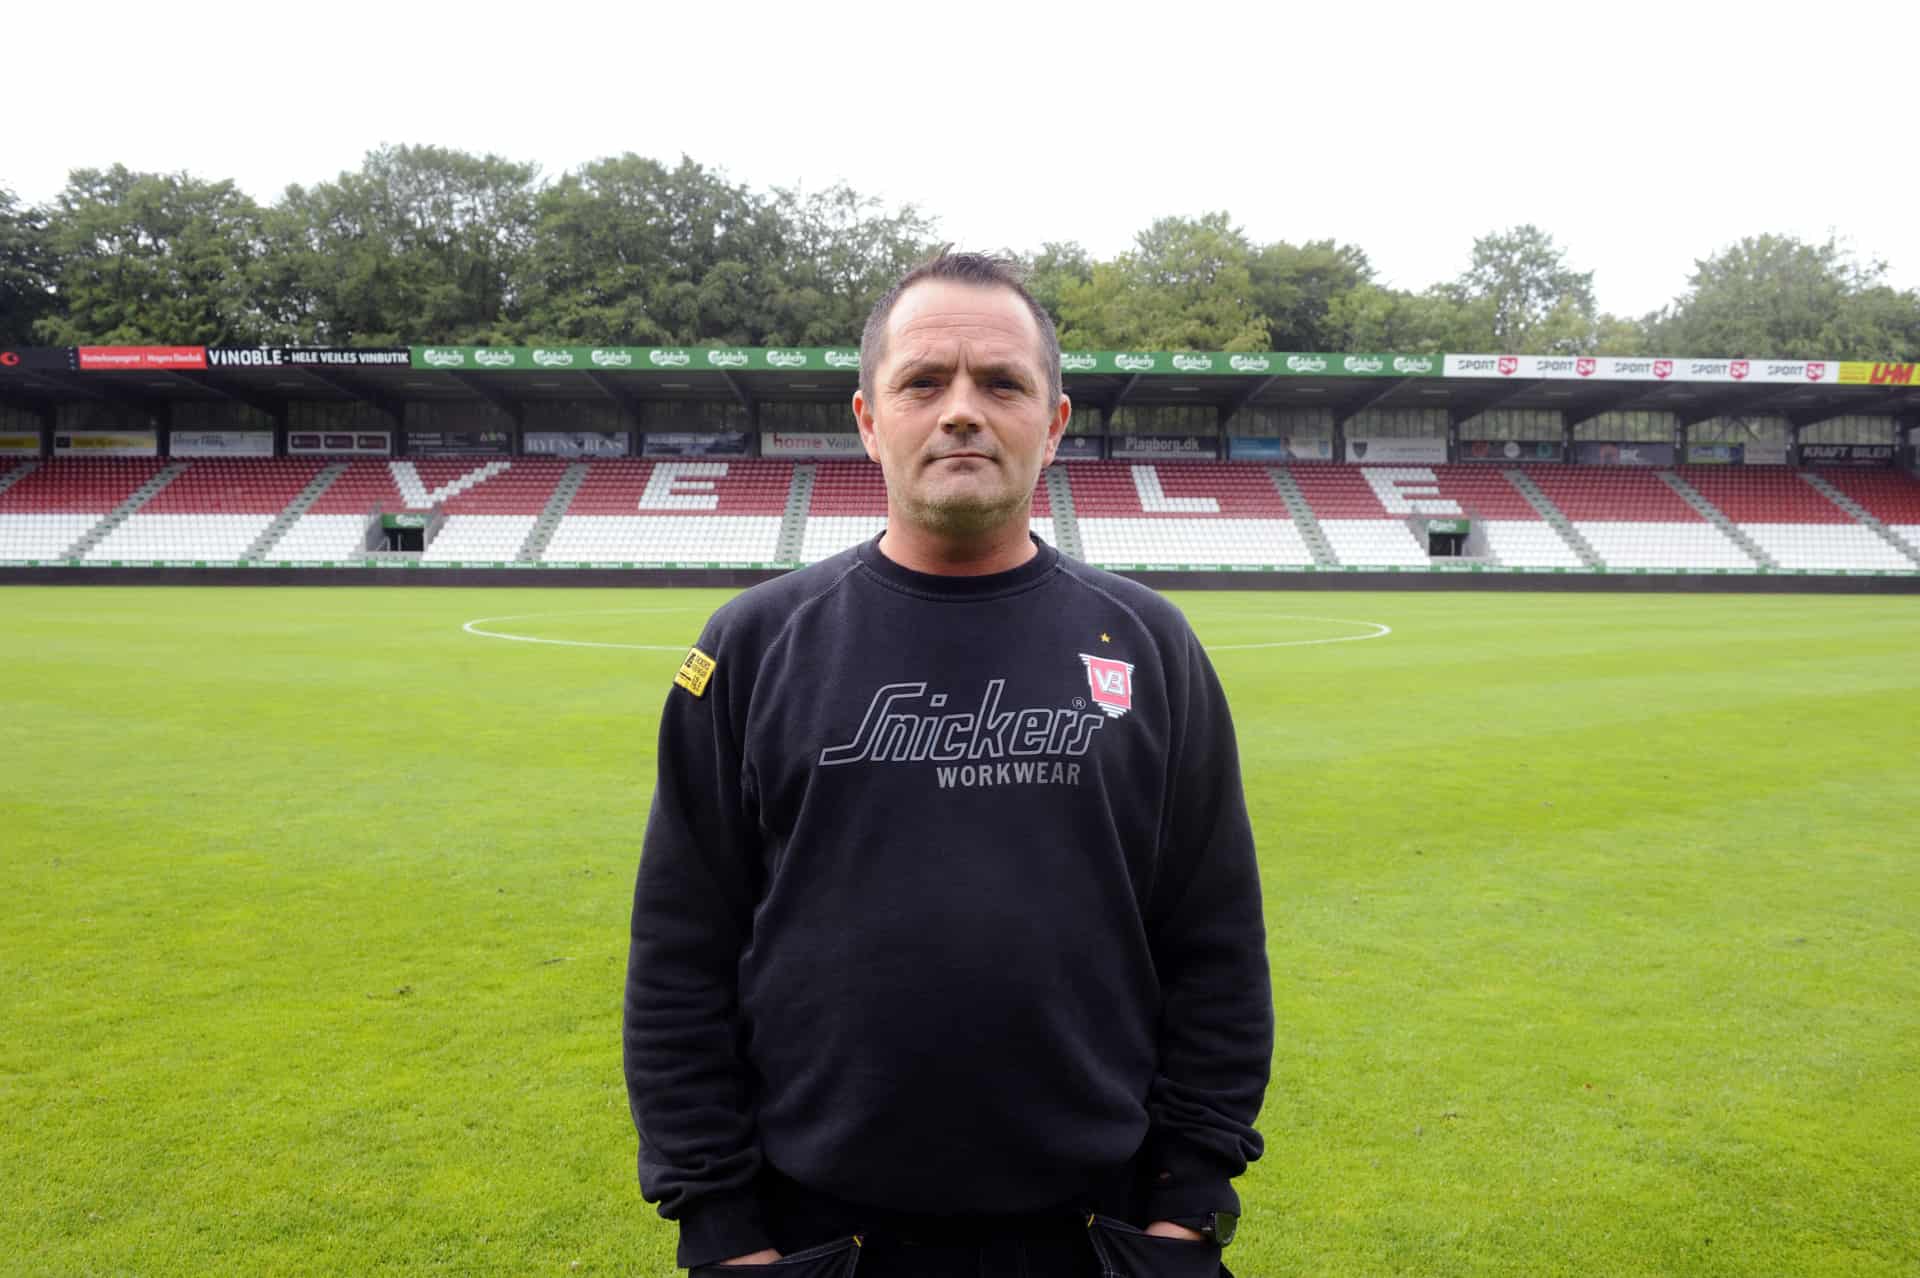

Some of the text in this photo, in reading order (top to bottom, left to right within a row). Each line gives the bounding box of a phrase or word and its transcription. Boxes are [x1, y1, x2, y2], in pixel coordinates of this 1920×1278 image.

[208, 350, 283, 365] VINOBLE
[292, 352, 318, 363] HELE
[358, 353, 409, 364] VINBUTIK
[1458, 360, 1495, 370] SPORT
[1537, 360, 1574, 371] SPORT
[1615, 362, 1650, 373] SPORT
[1691, 363, 1727, 374] SPORT
[1768, 365, 1803, 375] SPORT
[772, 433, 822, 449] home
[819, 679, 1105, 767] Snickers
[936, 761, 1081, 788] WORKWEAR
